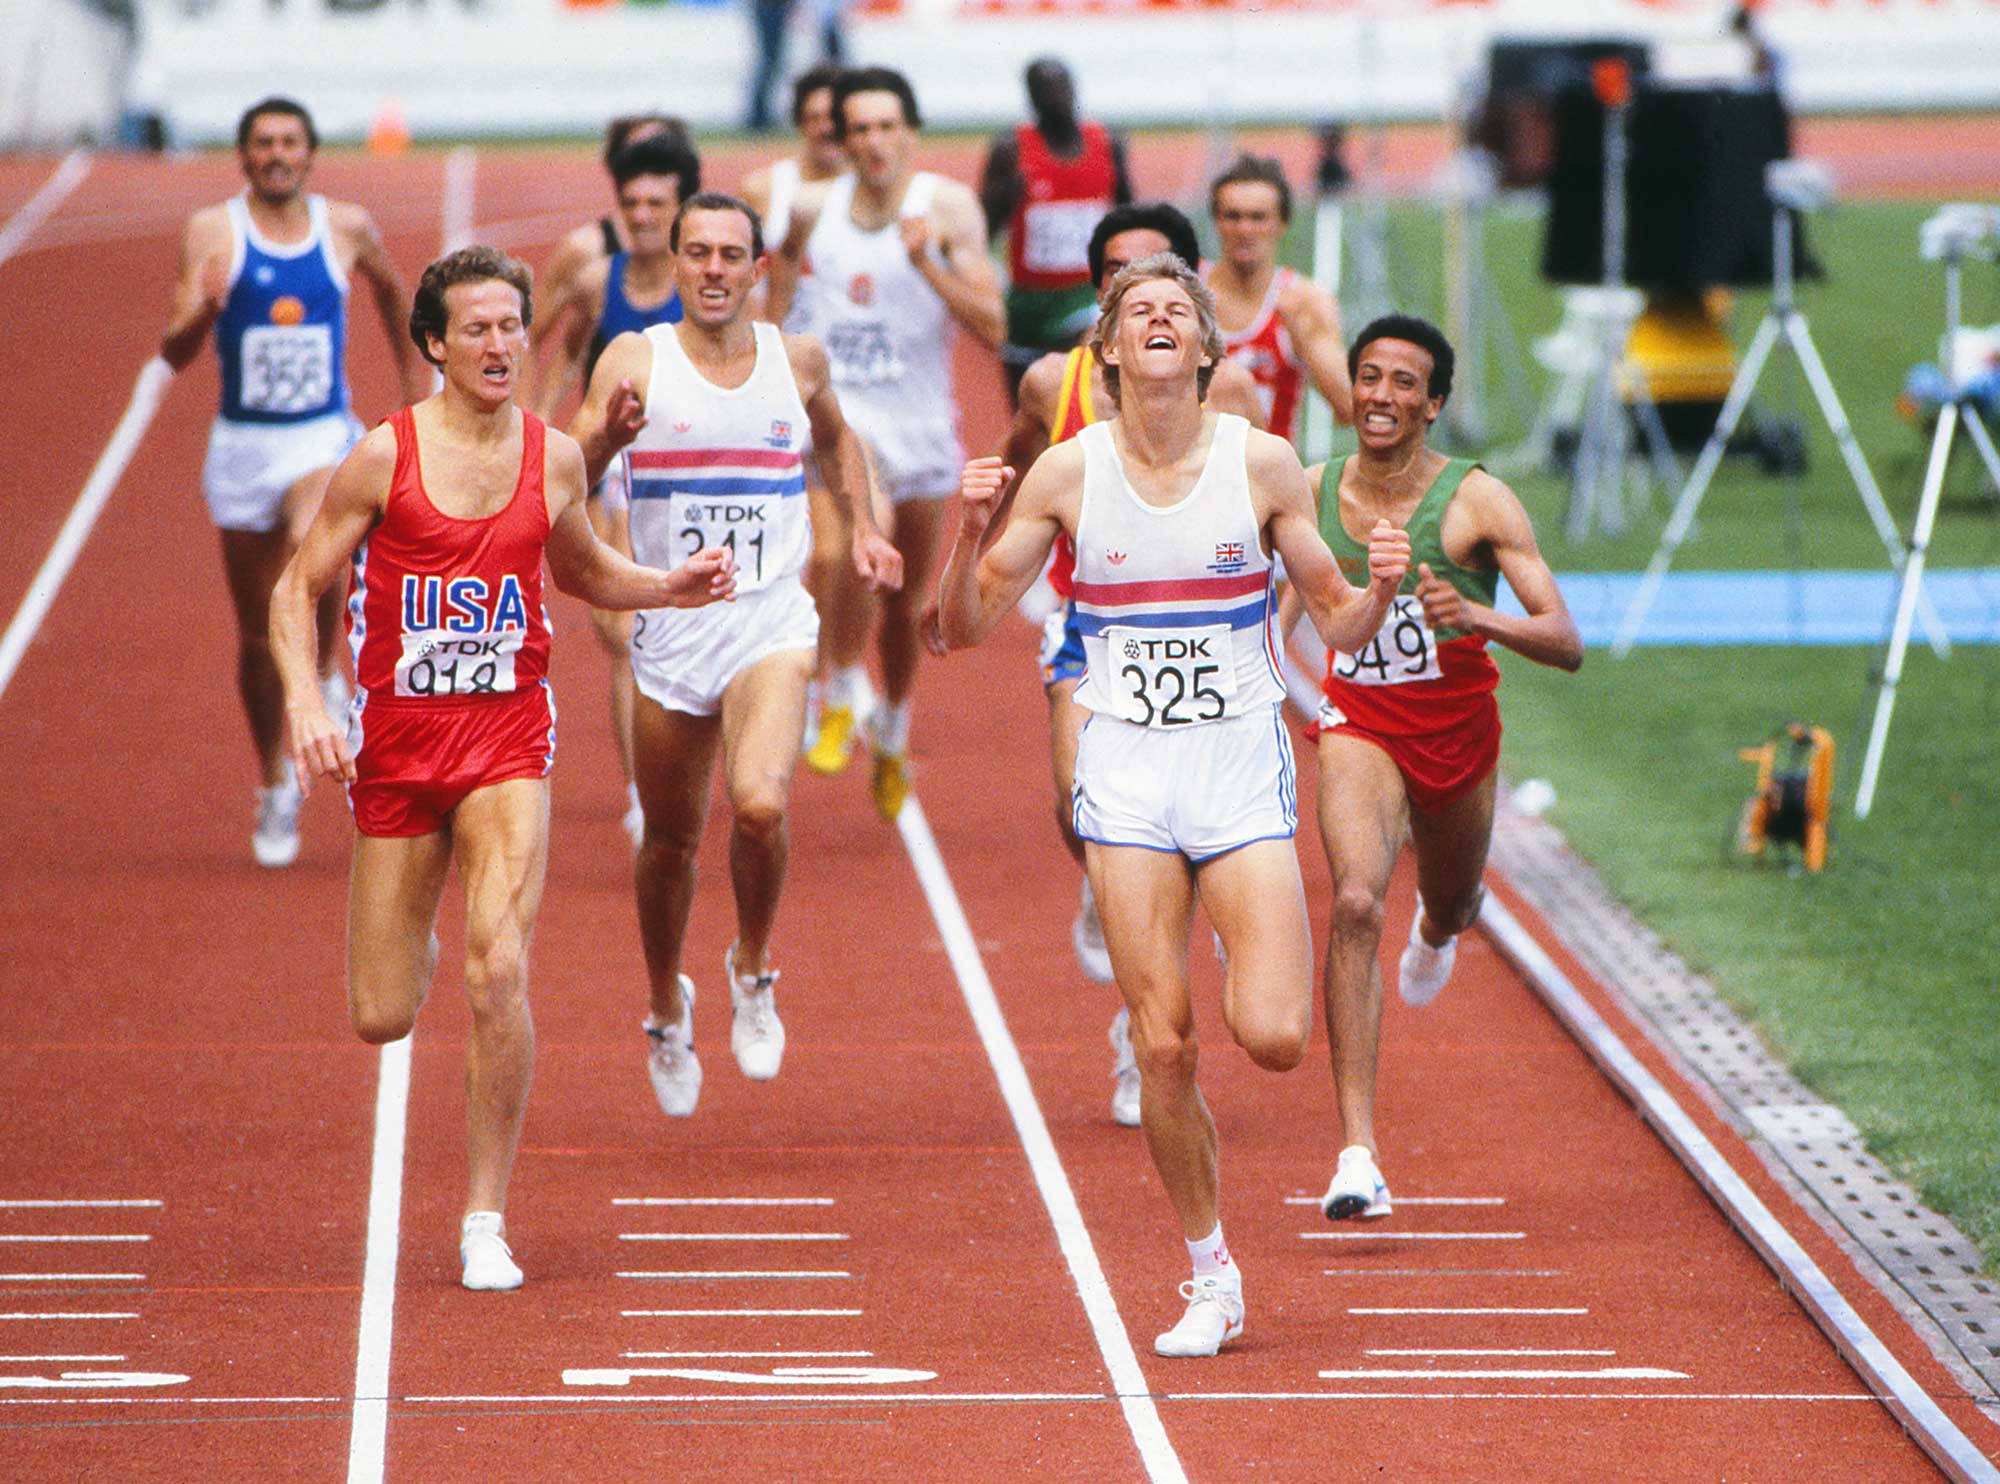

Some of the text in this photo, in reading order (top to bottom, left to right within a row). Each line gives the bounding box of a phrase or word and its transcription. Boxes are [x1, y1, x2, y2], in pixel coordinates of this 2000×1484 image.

[702, 504, 766, 523] TDK
[401, 574, 527, 634] USA
[437, 640, 503, 656] TDK
[1140, 637, 1211, 661] TDK
[1121, 664, 1226, 726] 325
